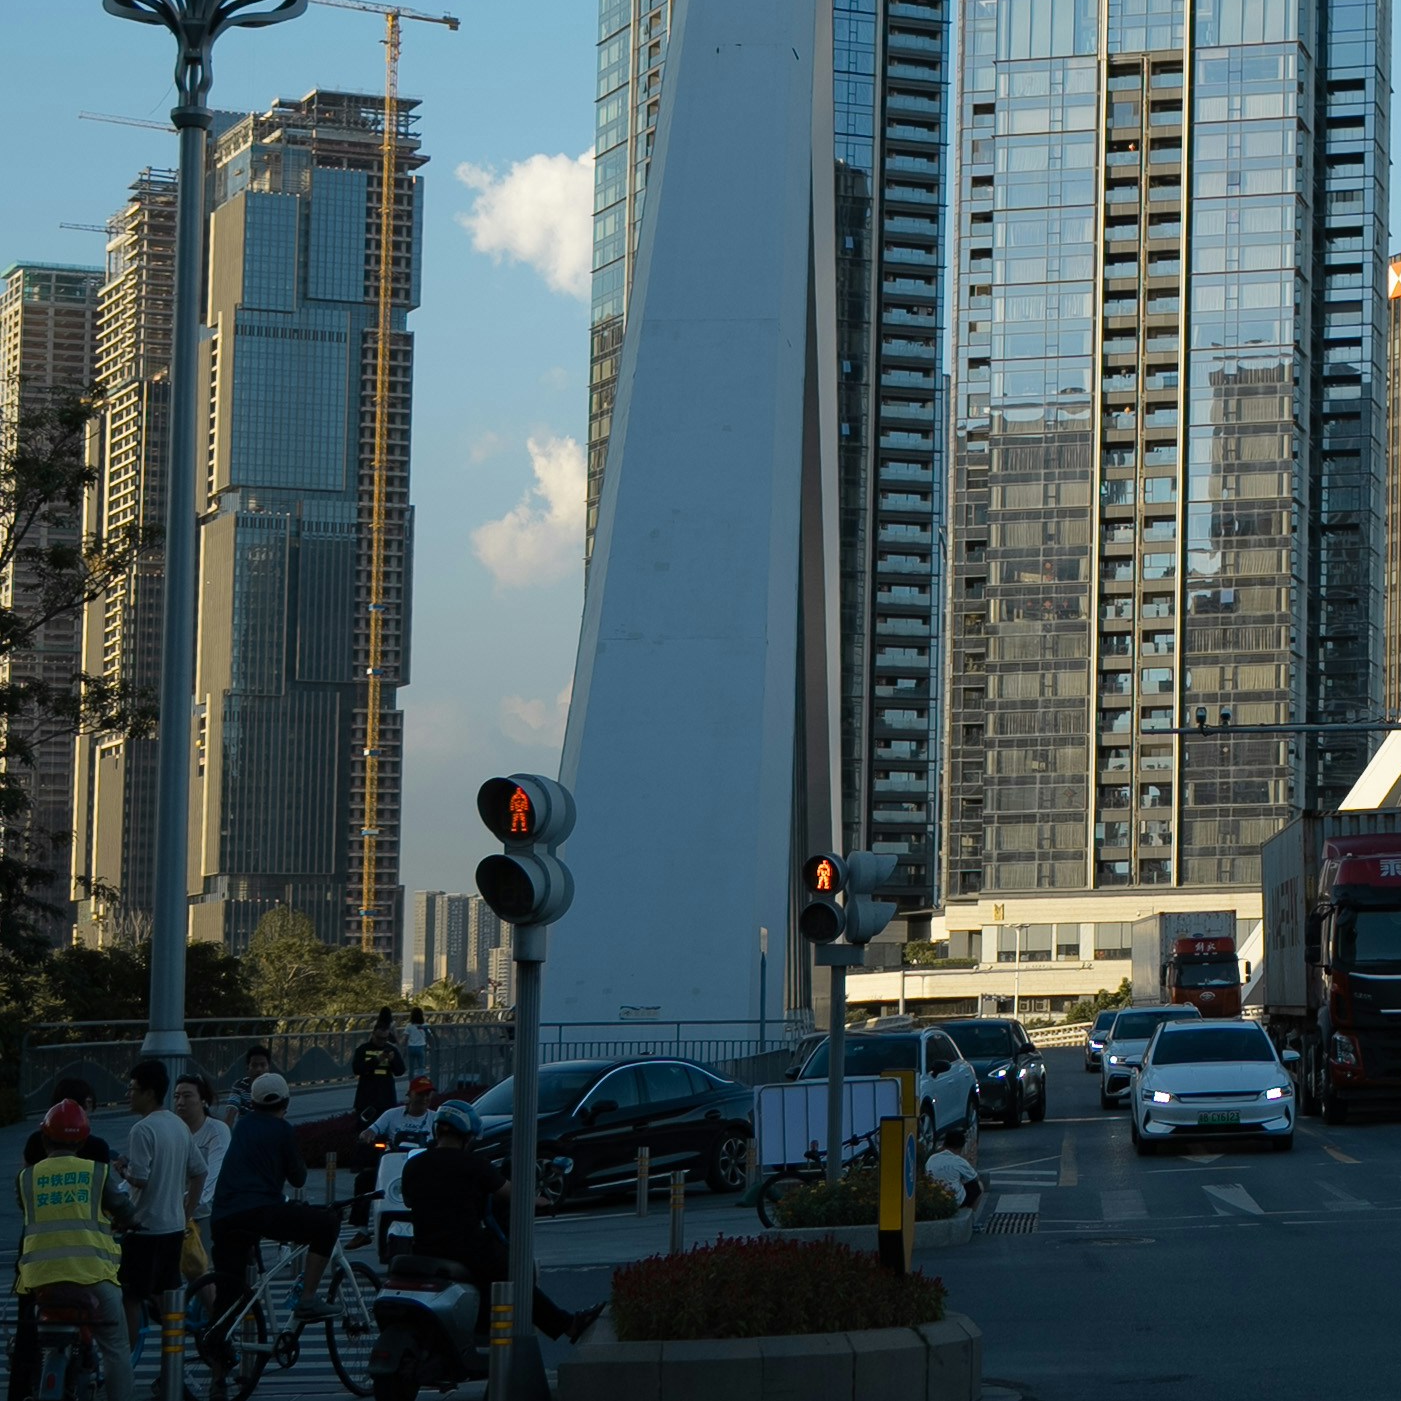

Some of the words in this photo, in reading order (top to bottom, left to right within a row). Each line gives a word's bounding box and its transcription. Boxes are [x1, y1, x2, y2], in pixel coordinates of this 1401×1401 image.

[37, 1171, 90, 1188] 中铁四局
[37, 1189, 89, 1207] 安装公司
